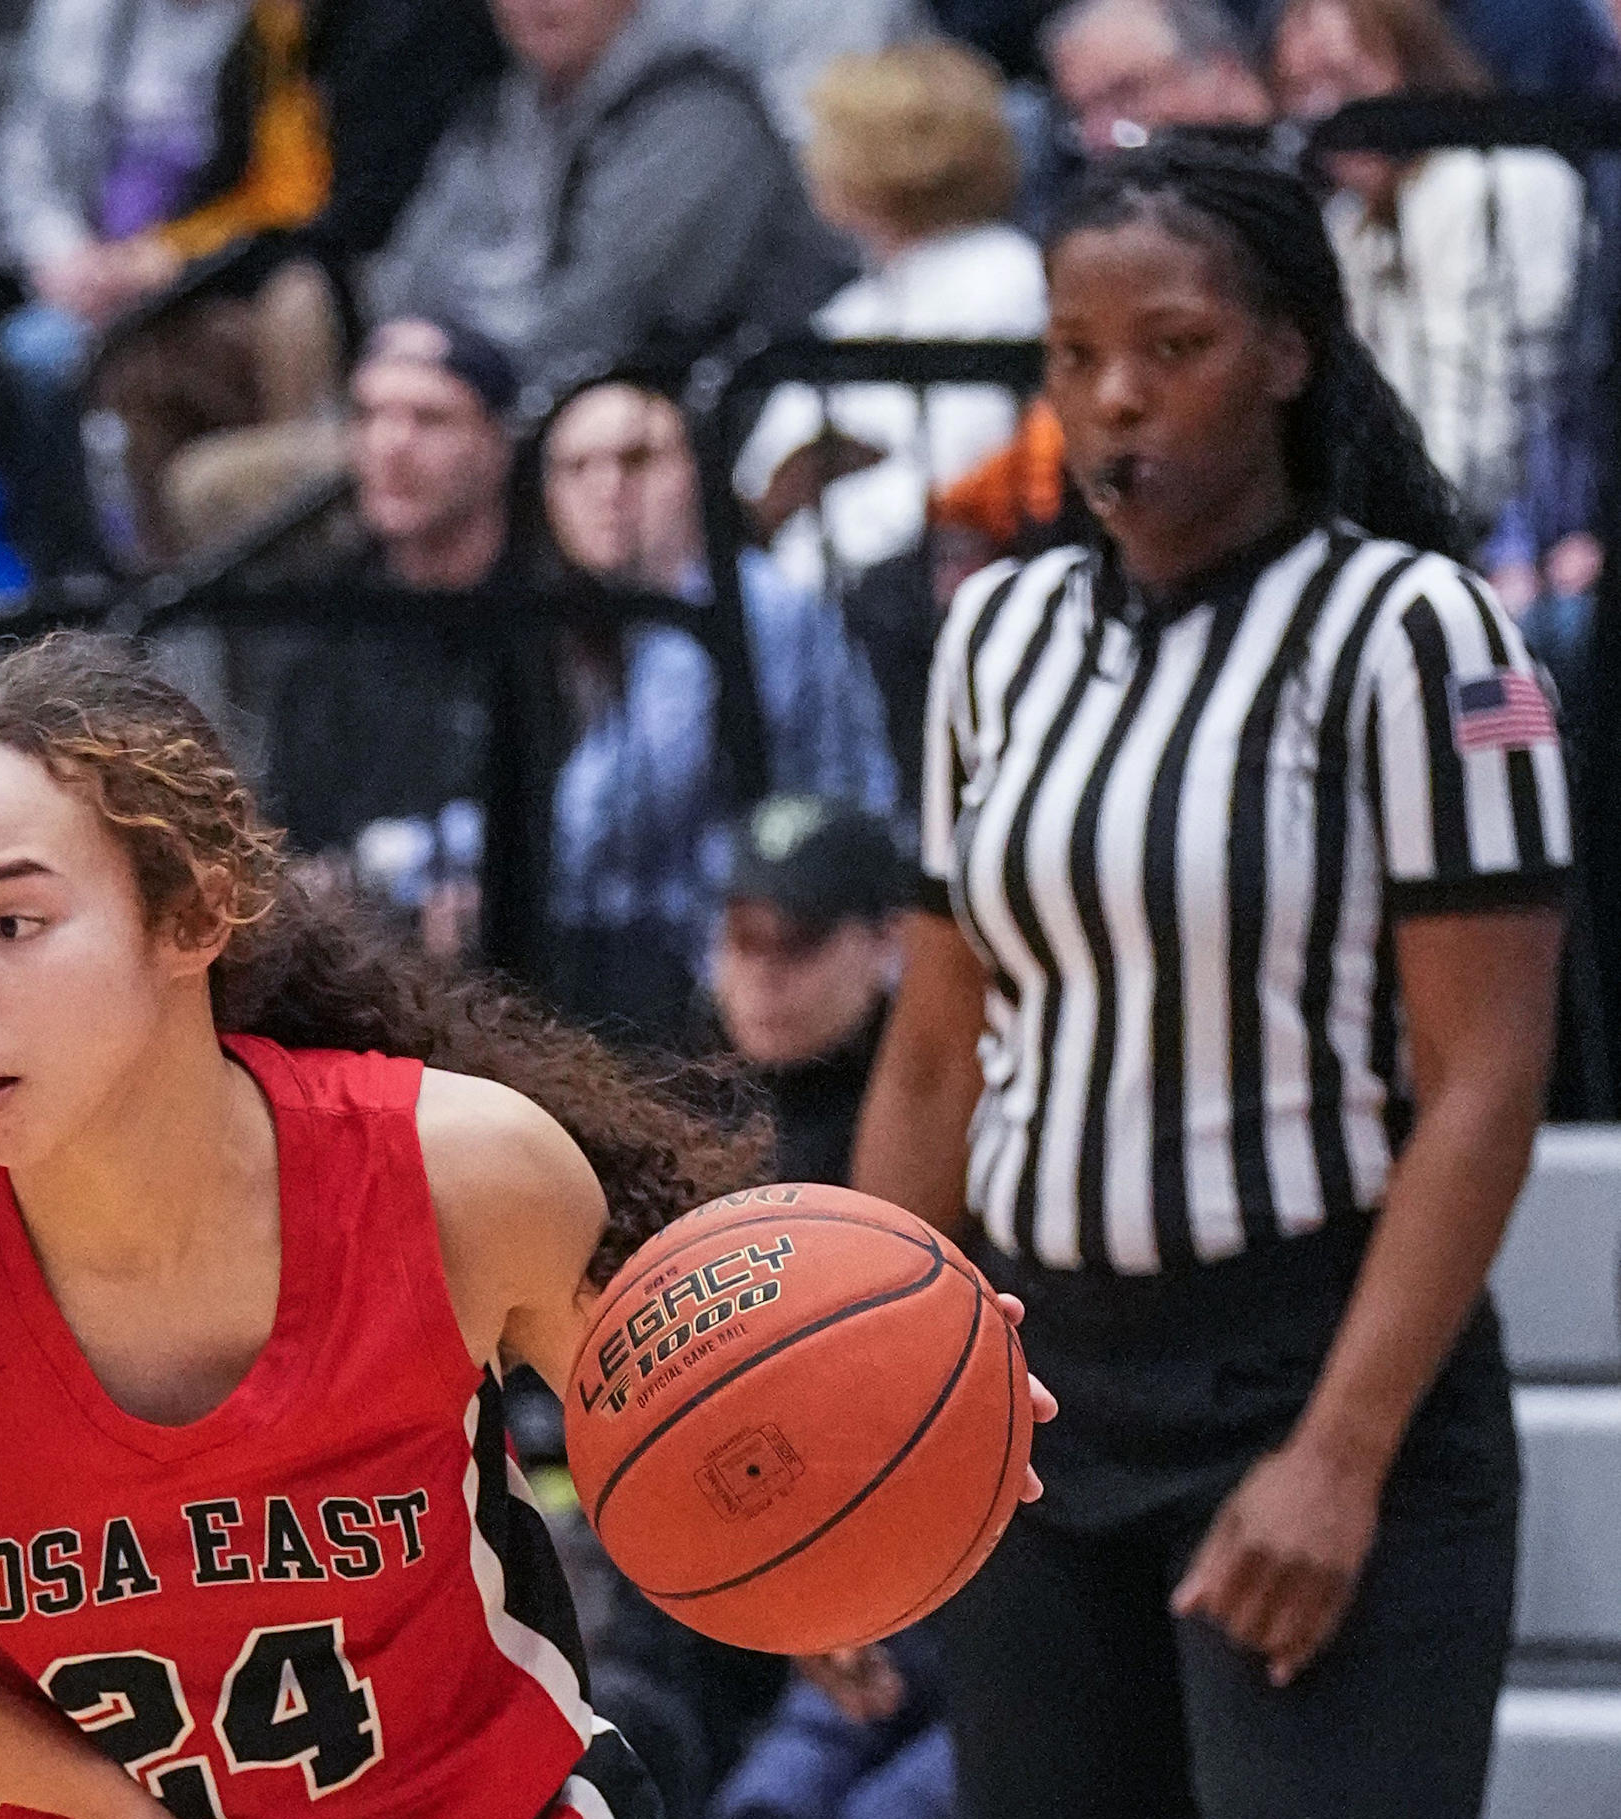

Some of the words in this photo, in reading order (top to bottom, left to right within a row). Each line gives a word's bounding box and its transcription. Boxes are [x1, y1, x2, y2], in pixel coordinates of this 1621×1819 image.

[579, 1234, 796, 1414] LEGACY
[636, 1363, 683, 1409] OFFICIAL
[682, 1340, 716, 1369] GAME
[716, 1323, 748, 1345] BALL
[181, 1488, 429, 1587] EAST
